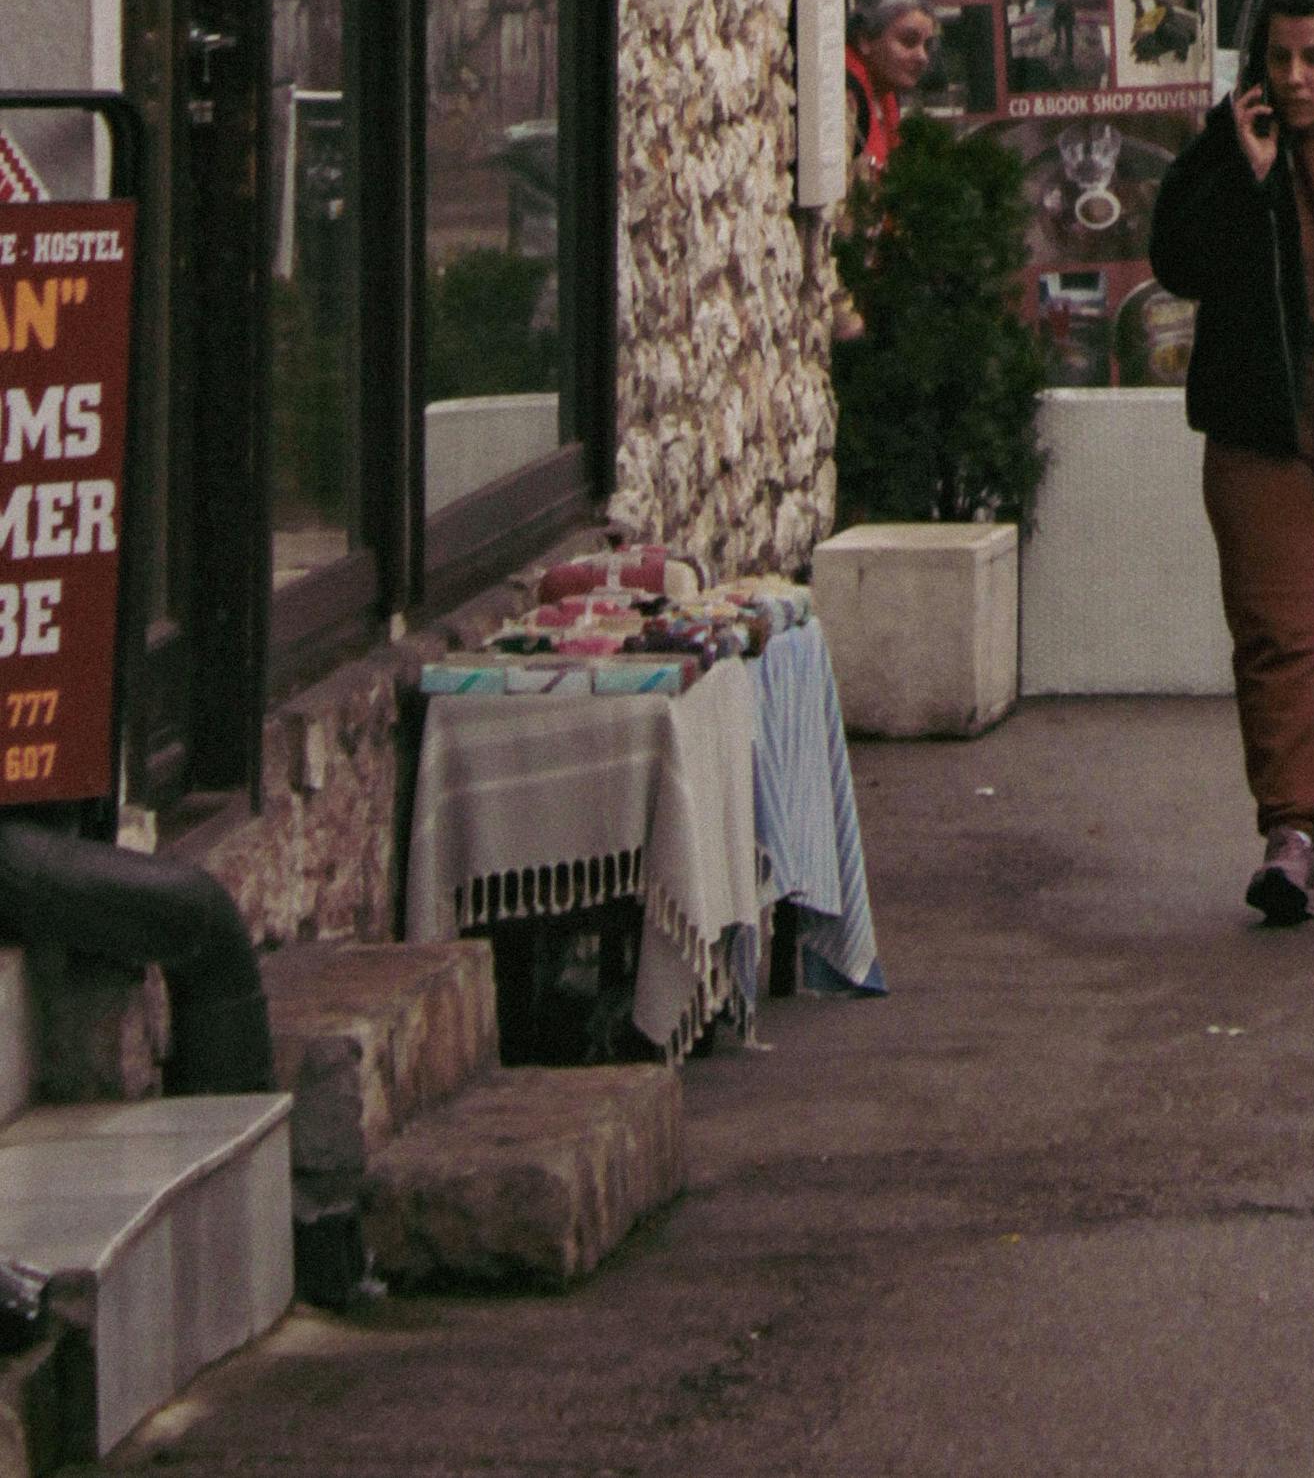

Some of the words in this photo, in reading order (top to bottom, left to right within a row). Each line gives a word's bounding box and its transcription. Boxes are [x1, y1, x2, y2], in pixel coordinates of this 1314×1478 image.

[1008, 98, 1030, 117] CD
[1092, 93, 1134, 113] SHOP
[32, 229, 125, 264] HOSTEL
[8, 690, 60, 729] 777
